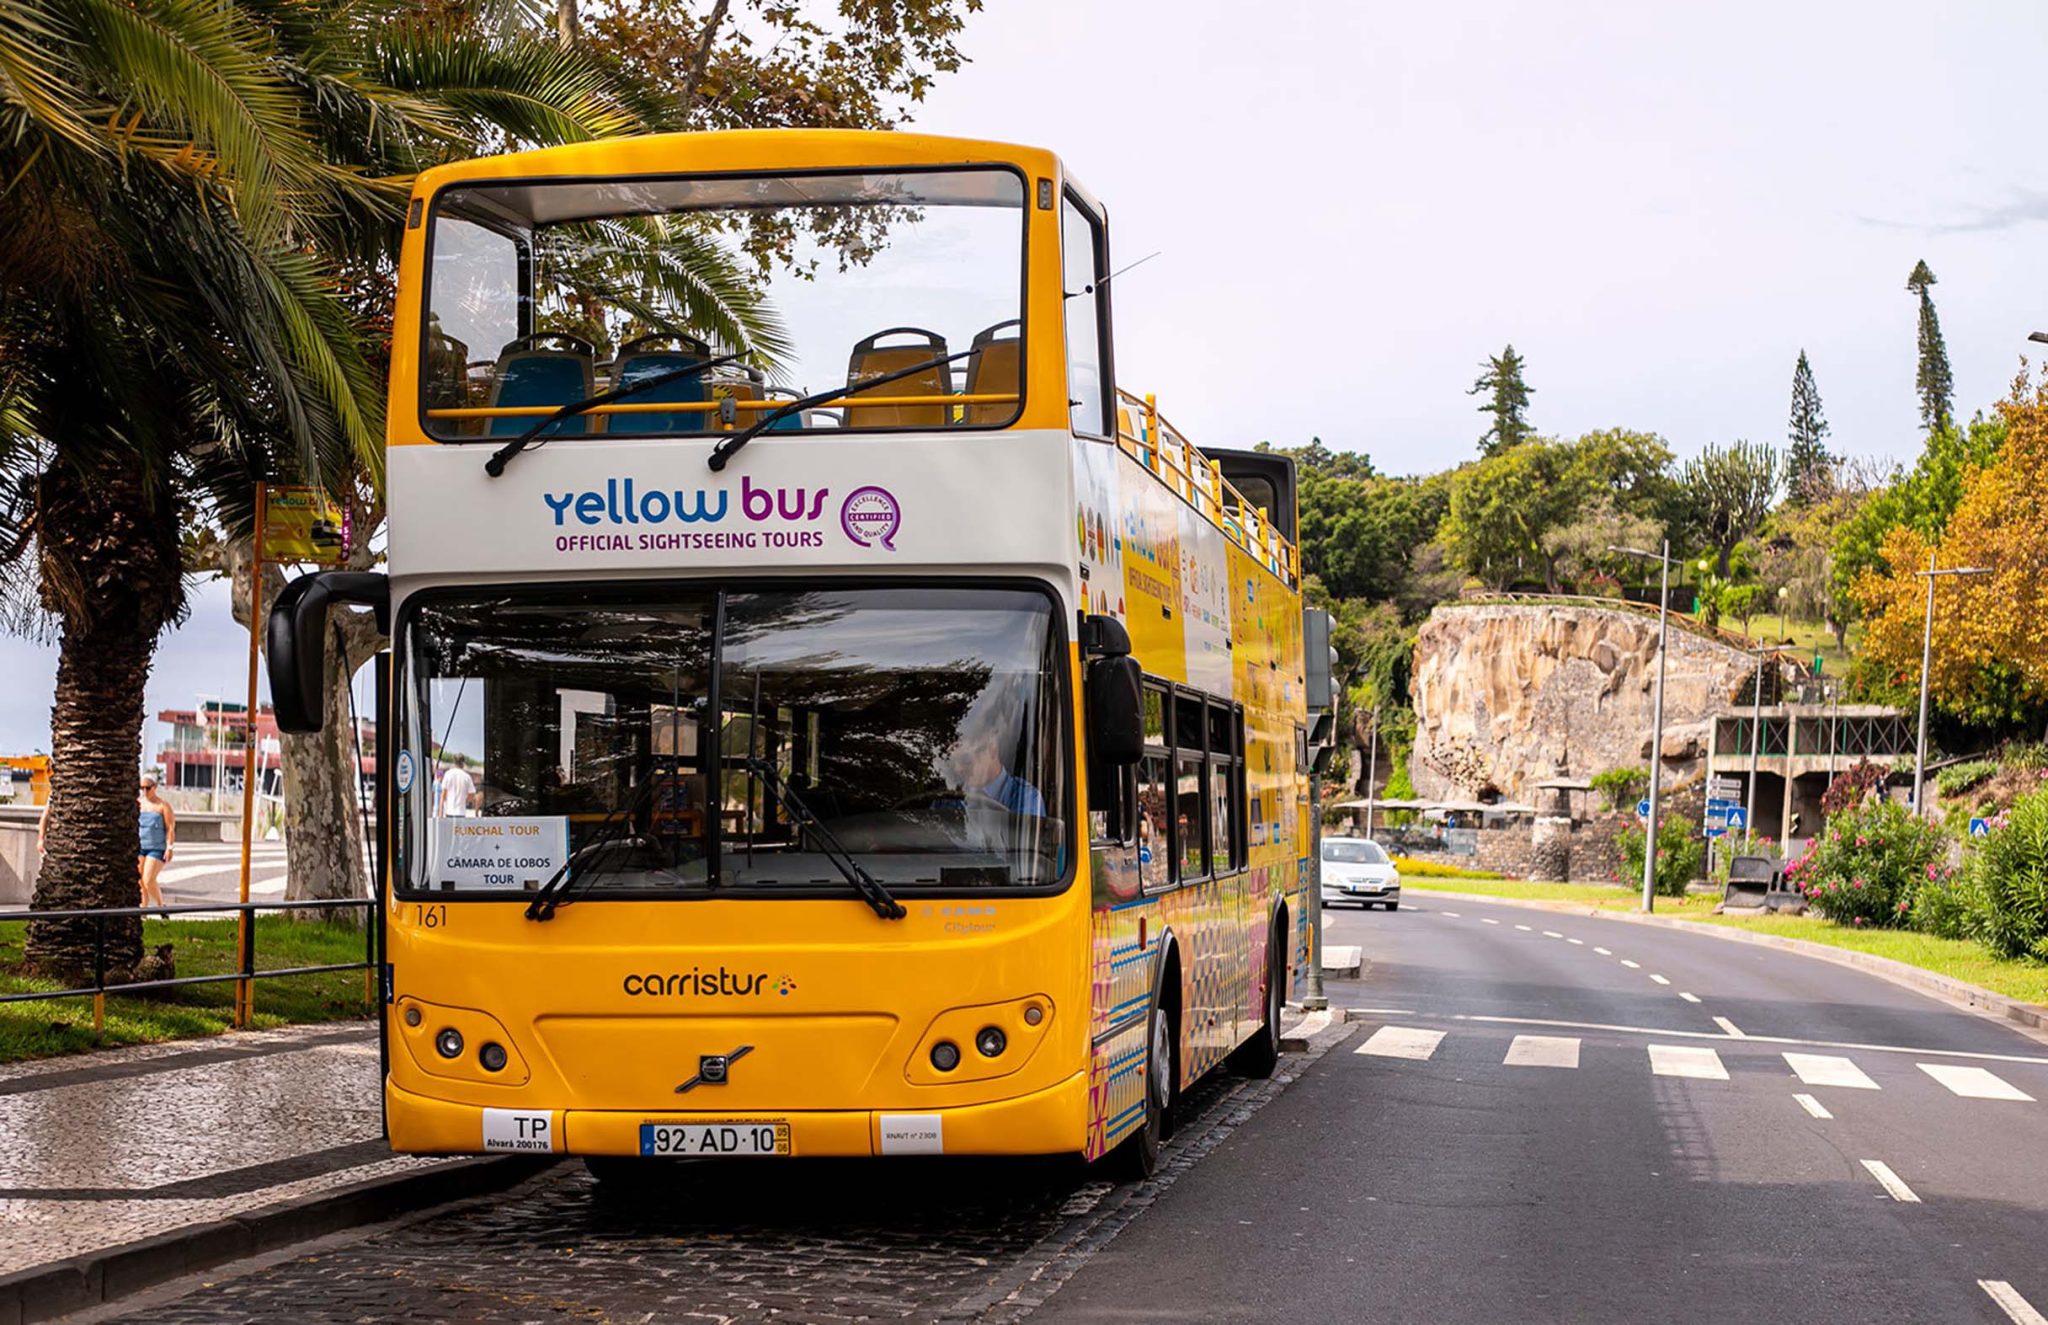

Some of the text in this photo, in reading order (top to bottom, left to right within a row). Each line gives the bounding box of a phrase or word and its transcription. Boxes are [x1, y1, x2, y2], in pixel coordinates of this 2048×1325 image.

[742, 476, 829, 522] bus
[851, 495, 890, 511] EXCELLENCE
[849, 513, 892, 521] CERTIFIED
[556, 531, 823, 551] OFFICIAL SIGHTSEEING TOURS
[454, 824, 540, 836] FUNCHAL TOUR
[498, 857, 512, 868] DE
[515, 857, 551, 868] LOBOS
[484, 874, 515, 884] TOUR
[416, 905, 447, 928] 161
[623, 967, 768, 996] carristur
[514, 1117, 548, 1138] TP
[487, 1139, 549, 1150] Alvará 200176
